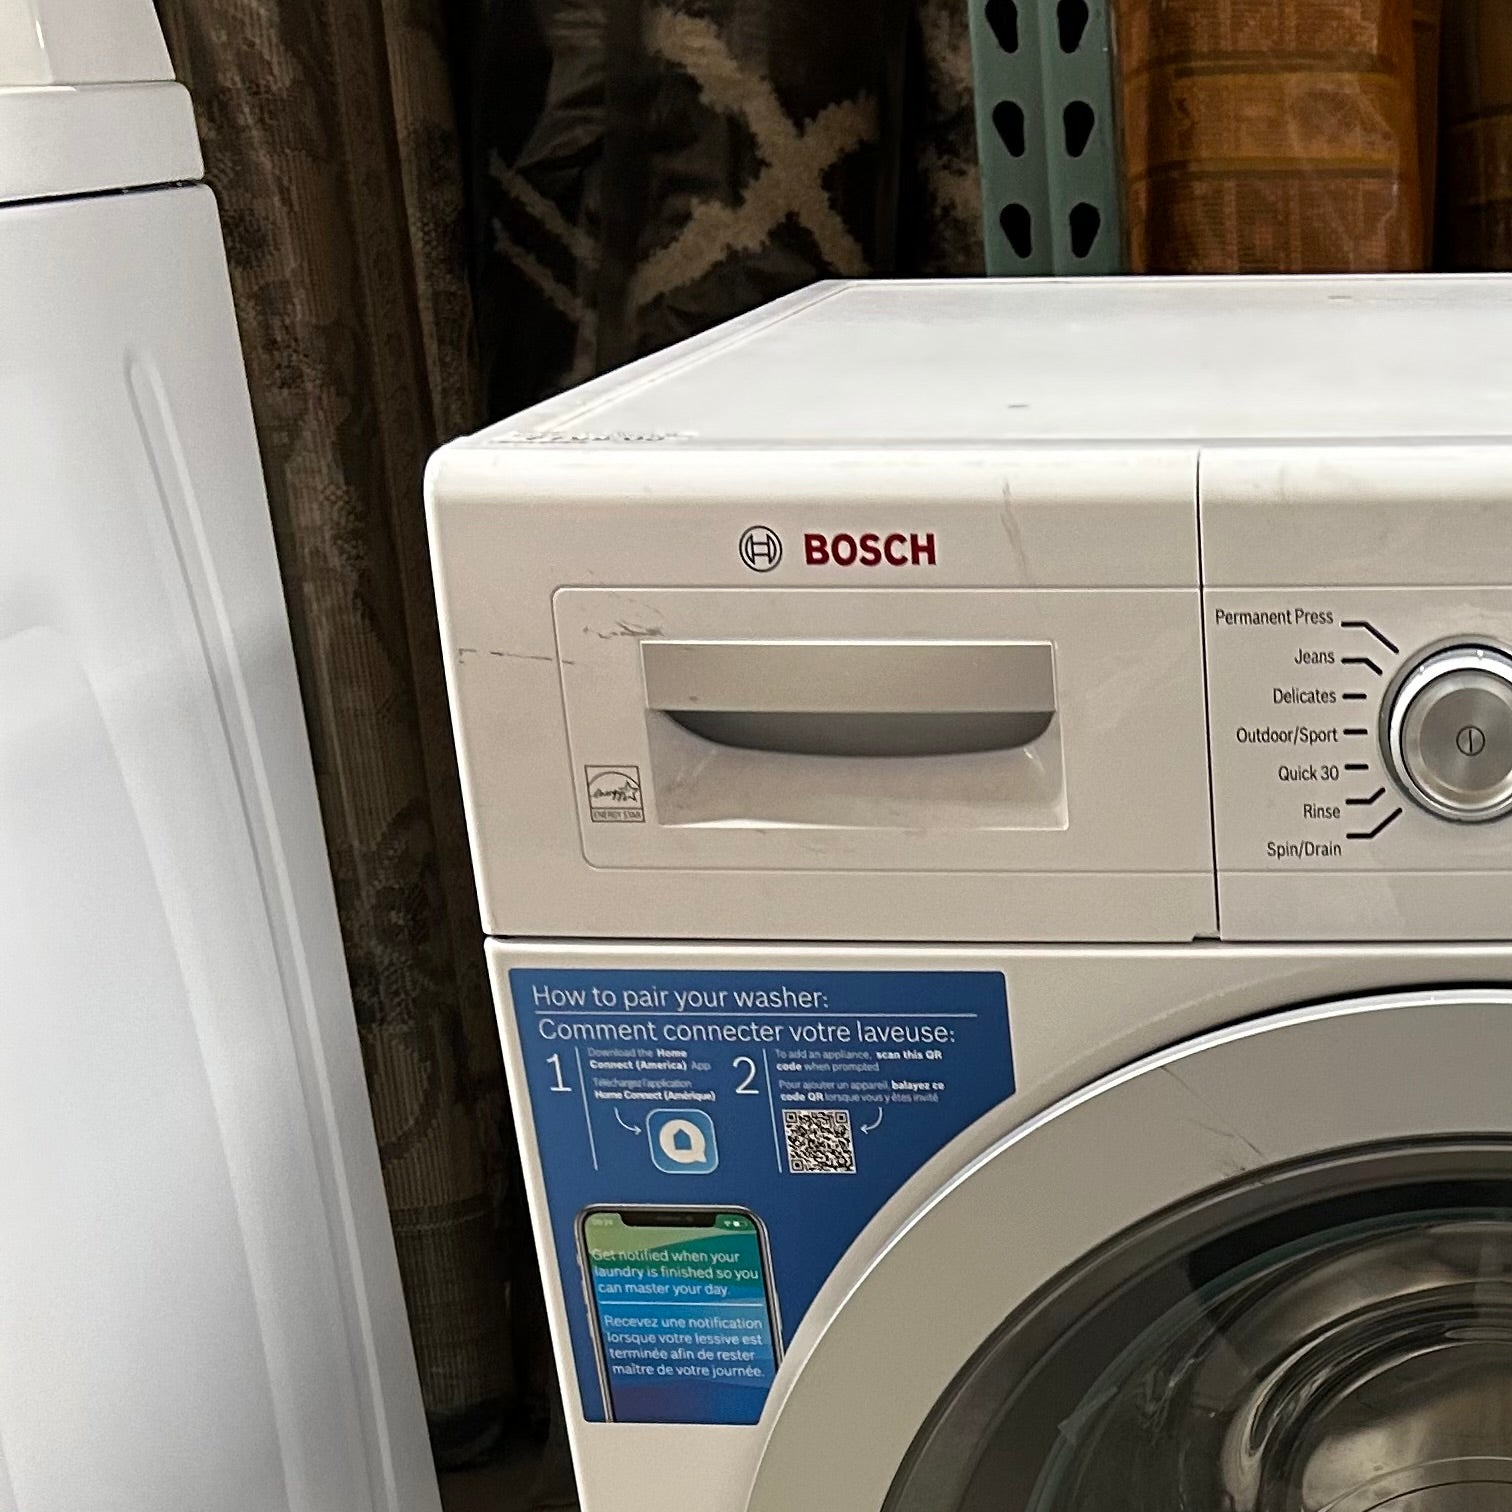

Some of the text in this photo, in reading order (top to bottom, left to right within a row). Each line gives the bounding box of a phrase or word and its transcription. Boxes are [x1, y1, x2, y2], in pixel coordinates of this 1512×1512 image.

[804, 533, 936, 566] BOSCH
[1215, 608, 1334, 625] Permanent Press
[1294, 648, 1335, 665] Jeans
[1272, 687, 1337, 704] Delicates
[1236, 726, 1339, 746] Outdoor/Sport
[1278, 765, 1340, 781] Quick 30
[1303, 803, 1341, 819] Rinse
[1266, 841, 1342, 859] Spin/Drain
[532, 985, 829, 1012] How to pair your washer:
[538, 1018, 956, 1043] Comment connecter votre laveuse:
[656, 1049, 687, 1058] Home
[876, 1052, 900, 1060] scan
[903, 1051, 923, 1060] this
[925, 1051, 942, 1060] QR
[546, 1053, 572, 1092] 1
[590, 1060, 634, 1070] Connect
[636, 1060, 687, 1071] (America)
[776, 1063, 802, 1071] code
[732, 1056, 760, 1094] 2
[891, 1081, 930, 1091] balayez
[594, 1090, 623, 1100] Home
[624, 1091, 663, 1100] Connect
[780, 1093, 806, 1101] code
[807, 1092, 824, 1101] QR
[592, 1249, 740, 1264] Get notified when your
[595, 1266, 759, 1281] laundry is finished so you
[599, 1284, 622, 1293] can
[625, 1283, 670, 1294] master
[673, 1285, 701, 1296] your
[604, 1315, 763, 1329] Recevez une notification
[607, 1332, 763, 1345] lorsque votre lessive est
[609, 1348, 755, 1361] terminée afin de rester
[612, 1363, 765, 1378] maître de votre journée.
